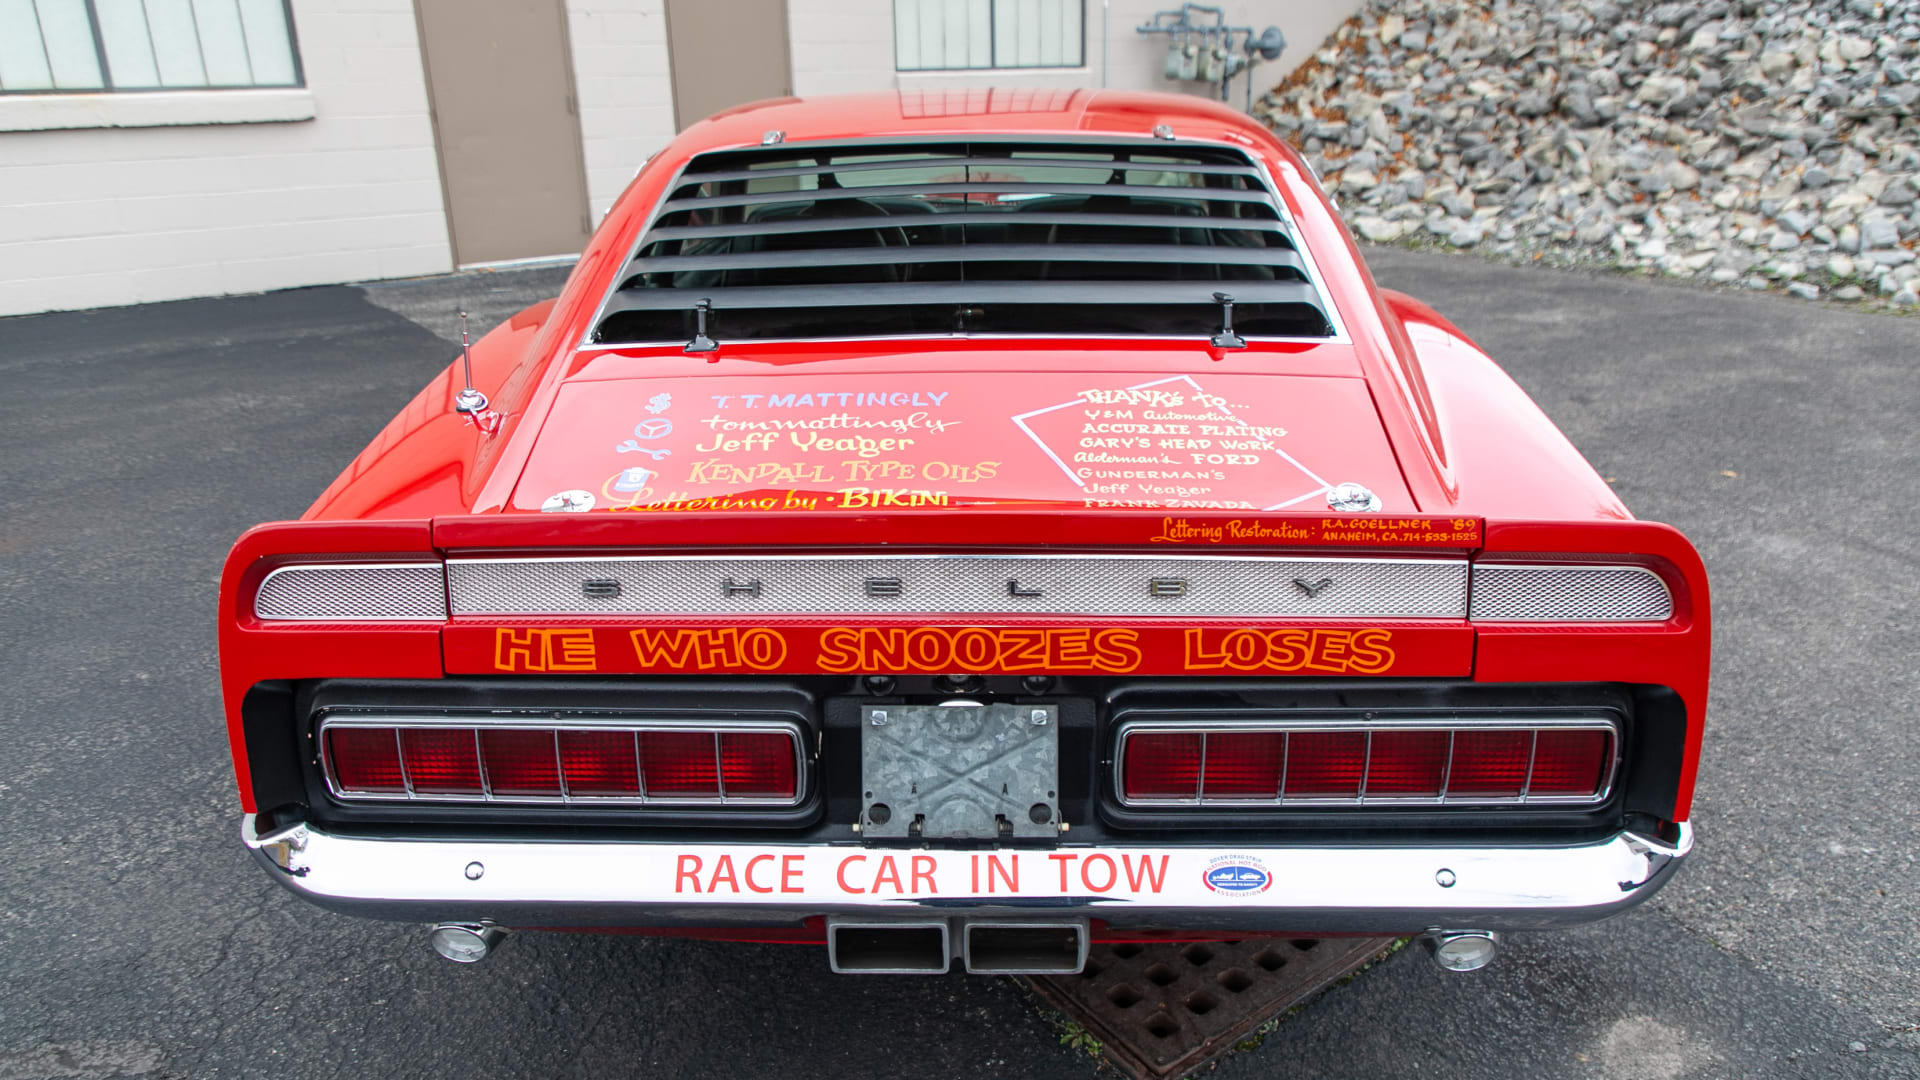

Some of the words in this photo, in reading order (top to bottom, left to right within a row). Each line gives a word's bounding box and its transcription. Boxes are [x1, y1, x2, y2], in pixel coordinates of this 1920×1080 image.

[767, 392, 949, 408] MATTINGLY
[1143, 410, 1237, 422] Automotive
[1082, 423, 1191, 434] ACCURATE
[1199, 425, 1288, 437] PLATING
[696, 432, 779, 452] Jeff
[790, 431, 915, 458] Yeager
[1080, 437, 1151, 449] GARY'S
[1158, 438, 1212, 449] HEAD
[1074, 452, 1182, 465] Alderman's
[1190, 453, 1260, 465] FORD
[685, 458, 834, 485] KENDALL
[841, 460, 916, 482] TYPE
[922, 461, 1002, 483] OILS
[602, 470, 778, 512] Lettering
[782, 489, 818, 511] by
[1083, 483, 1130, 494] Jeff
[1138, 484, 1211, 497] Yeager
[1083, 498, 1159, 508] FRANK
[1165, 499, 1257, 509] ZAVADA
[1150, 516, 1222, 543] Lettering
[1225, 519, 1316, 539] Restoration:
[581, 577, 1333, 600] SHELBY
[494, 627, 597, 671] HE
[630, 628, 787, 670] WHO
[816, 627, 1142, 673] SNOOZES
[1184, 628, 1396, 673] LOSES
[675, 854, 805, 893] RACE
[836, 854, 938, 893] CAR
[971, 854, 1019, 893] IN
[1048, 853, 1170, 893] TOW
